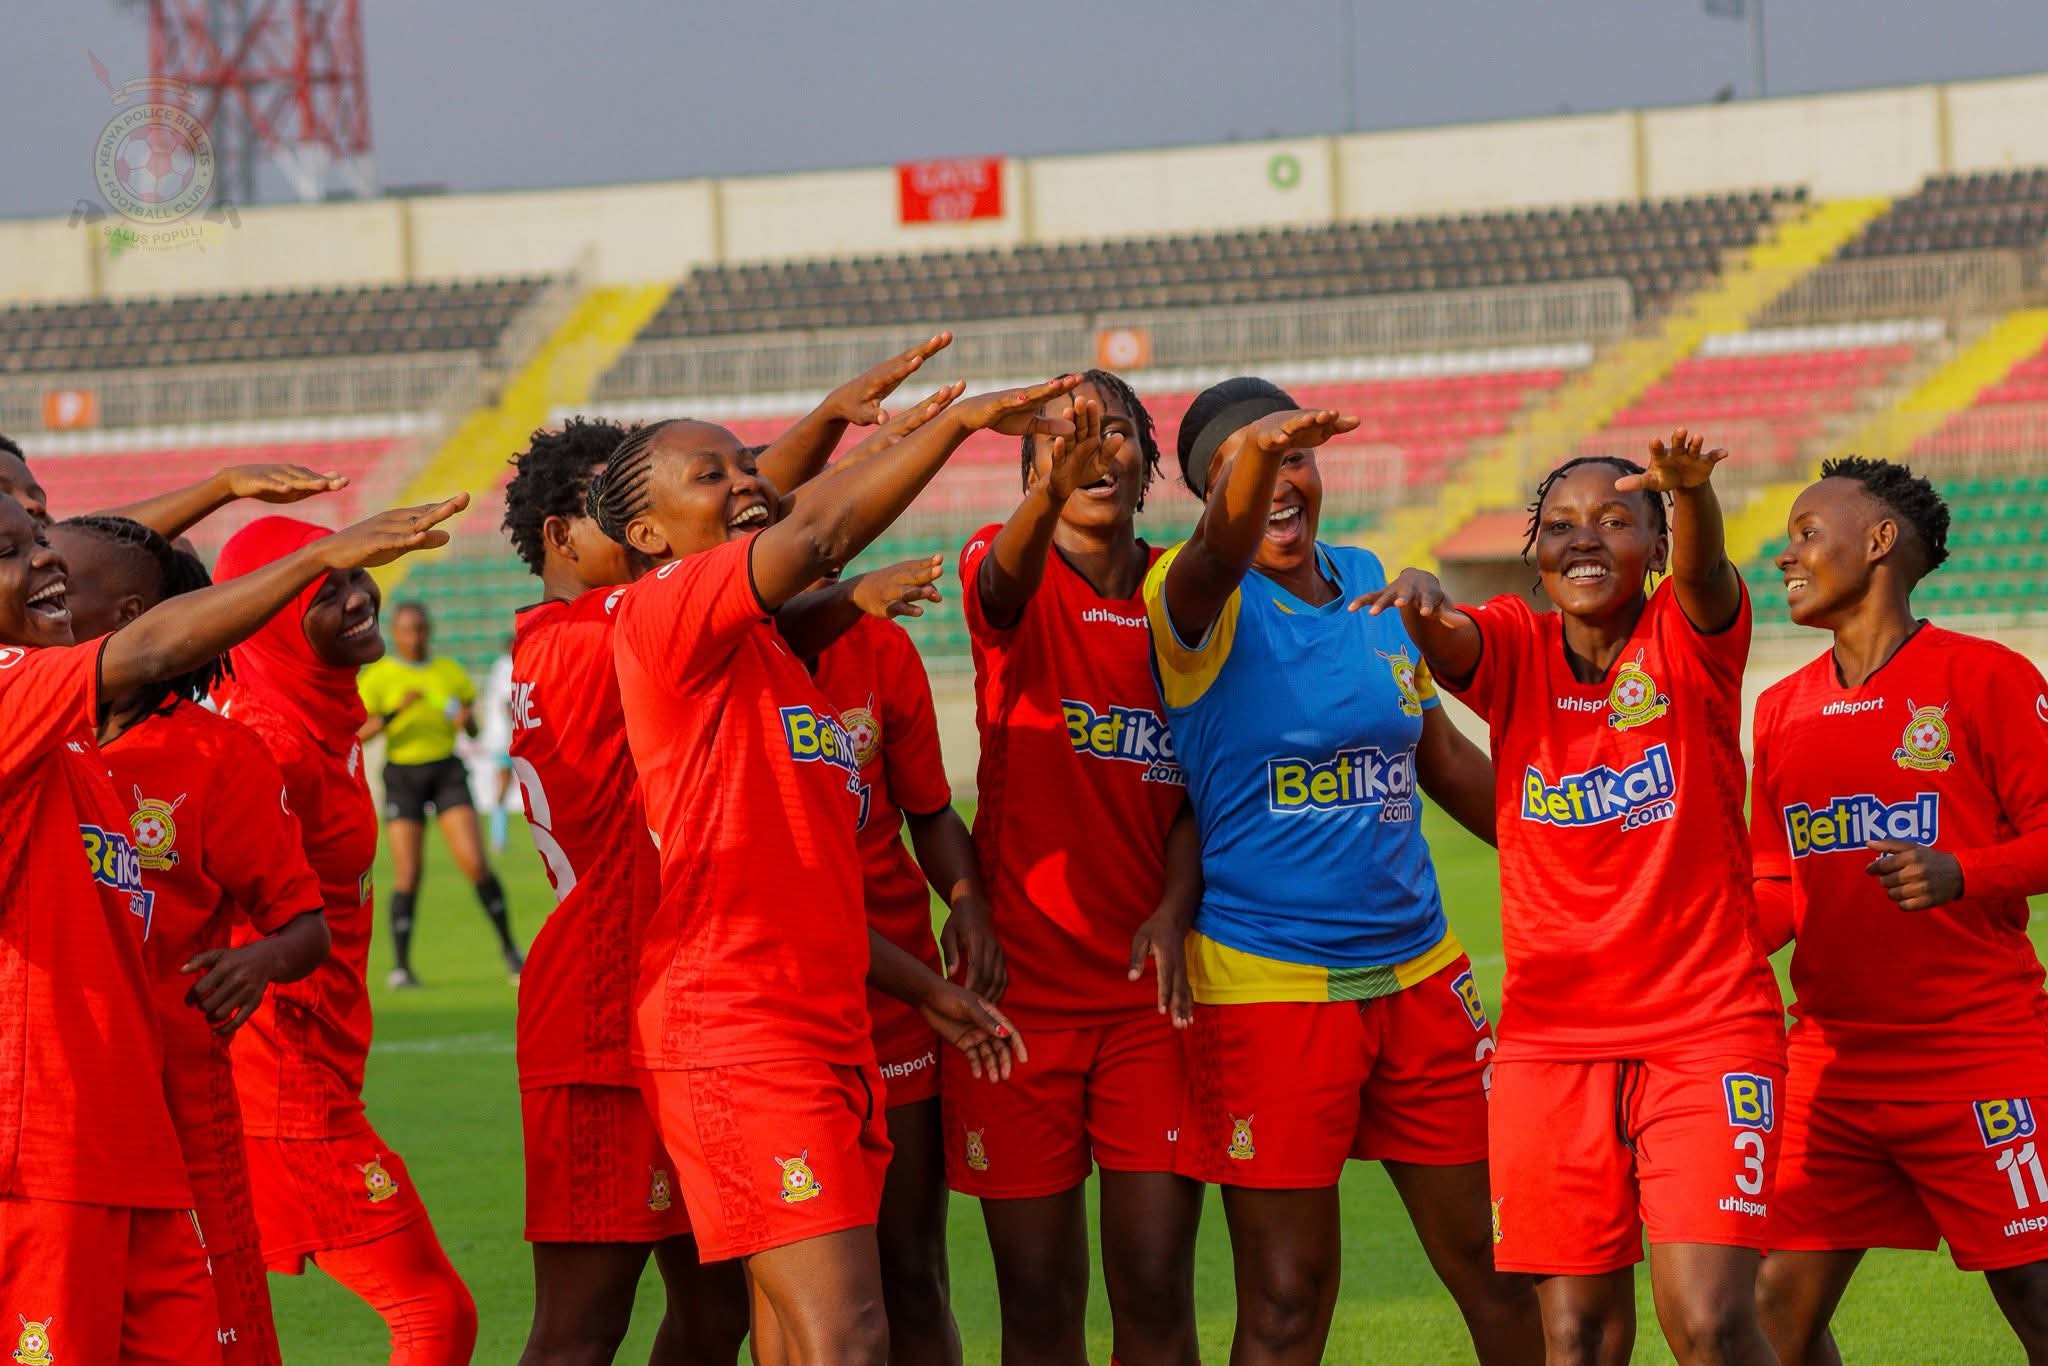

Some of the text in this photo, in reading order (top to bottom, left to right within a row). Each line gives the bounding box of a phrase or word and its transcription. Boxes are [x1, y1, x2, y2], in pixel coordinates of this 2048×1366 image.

[1082, 607, 1149, 629] uhlsport
[1822, 696, 1885, 716] uhlsport
[1526, 752, 1670, 822] Betika!
[1621, 802, 1674, 831] .com
[1789, 799, 1932, 852] Betika!
[1730, 1079, 1771, 1127] B!
[1733, 1131, 1765, 1195] 3
[1995, 1141, 2048, 1210] 11
[1719, 1196, 1767, 1218] uhlsport
